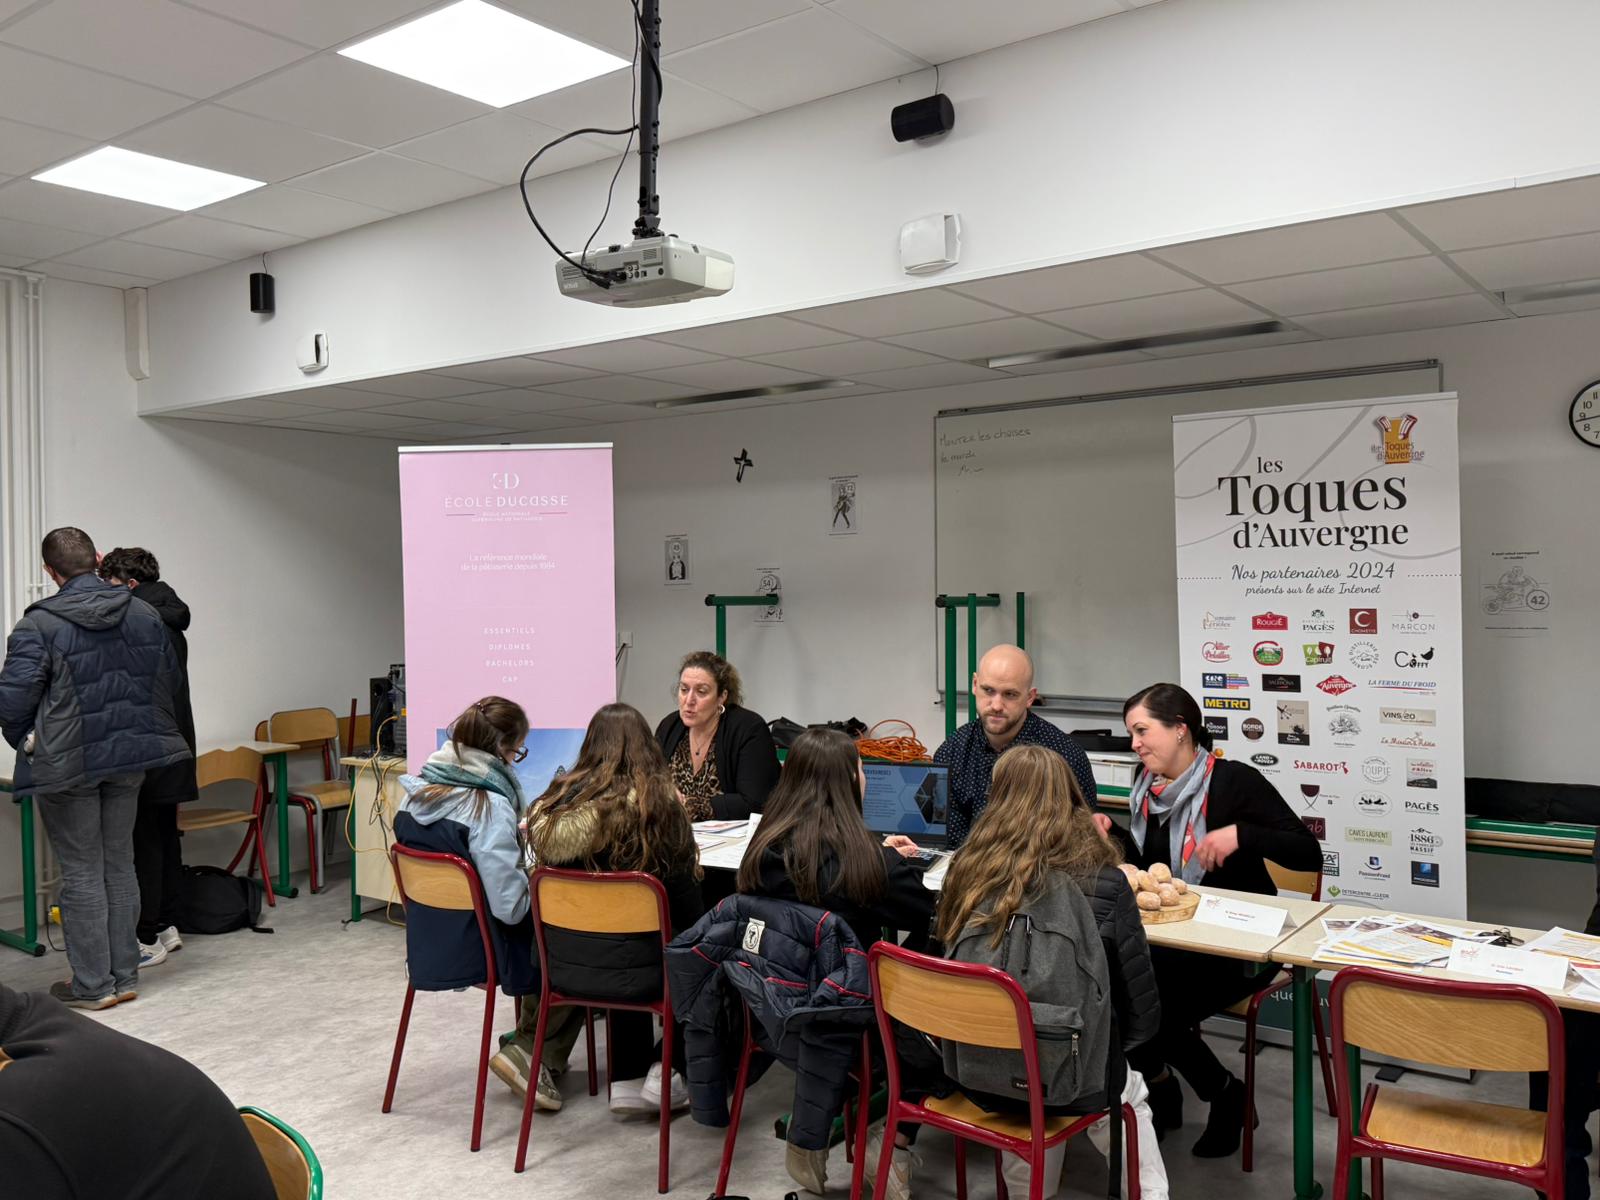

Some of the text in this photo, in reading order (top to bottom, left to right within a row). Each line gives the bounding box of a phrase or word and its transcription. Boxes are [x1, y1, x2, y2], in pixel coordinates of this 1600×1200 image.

[1583, 401, 1593, 410] 10
[1584, 423, 1591, 432] 8
[1594, 431, 1600, 439] 7
[1257, 457, 1283, 473] les
[1218, 475, 1408, 523] Toques
[1233, 522, 1409, 551] d'Auvergne
[1231, 562, 1395, 583] Nos partenaires 2024
[1287, 585, 1303, 595] sur
[1306, 583, 1314, 594] le
[1317, 583, 1335, 594] site
[1339, 582, 1381, 595] Internet
[1530, 595, 1545, 605] 42
[1392, 623, 1436, 632] MARCON
[1205, 699, 1249, 709] METRO
[1294, 760, 1340, 772] SABAROT
[1410, 833, 1434, 844] 1886
